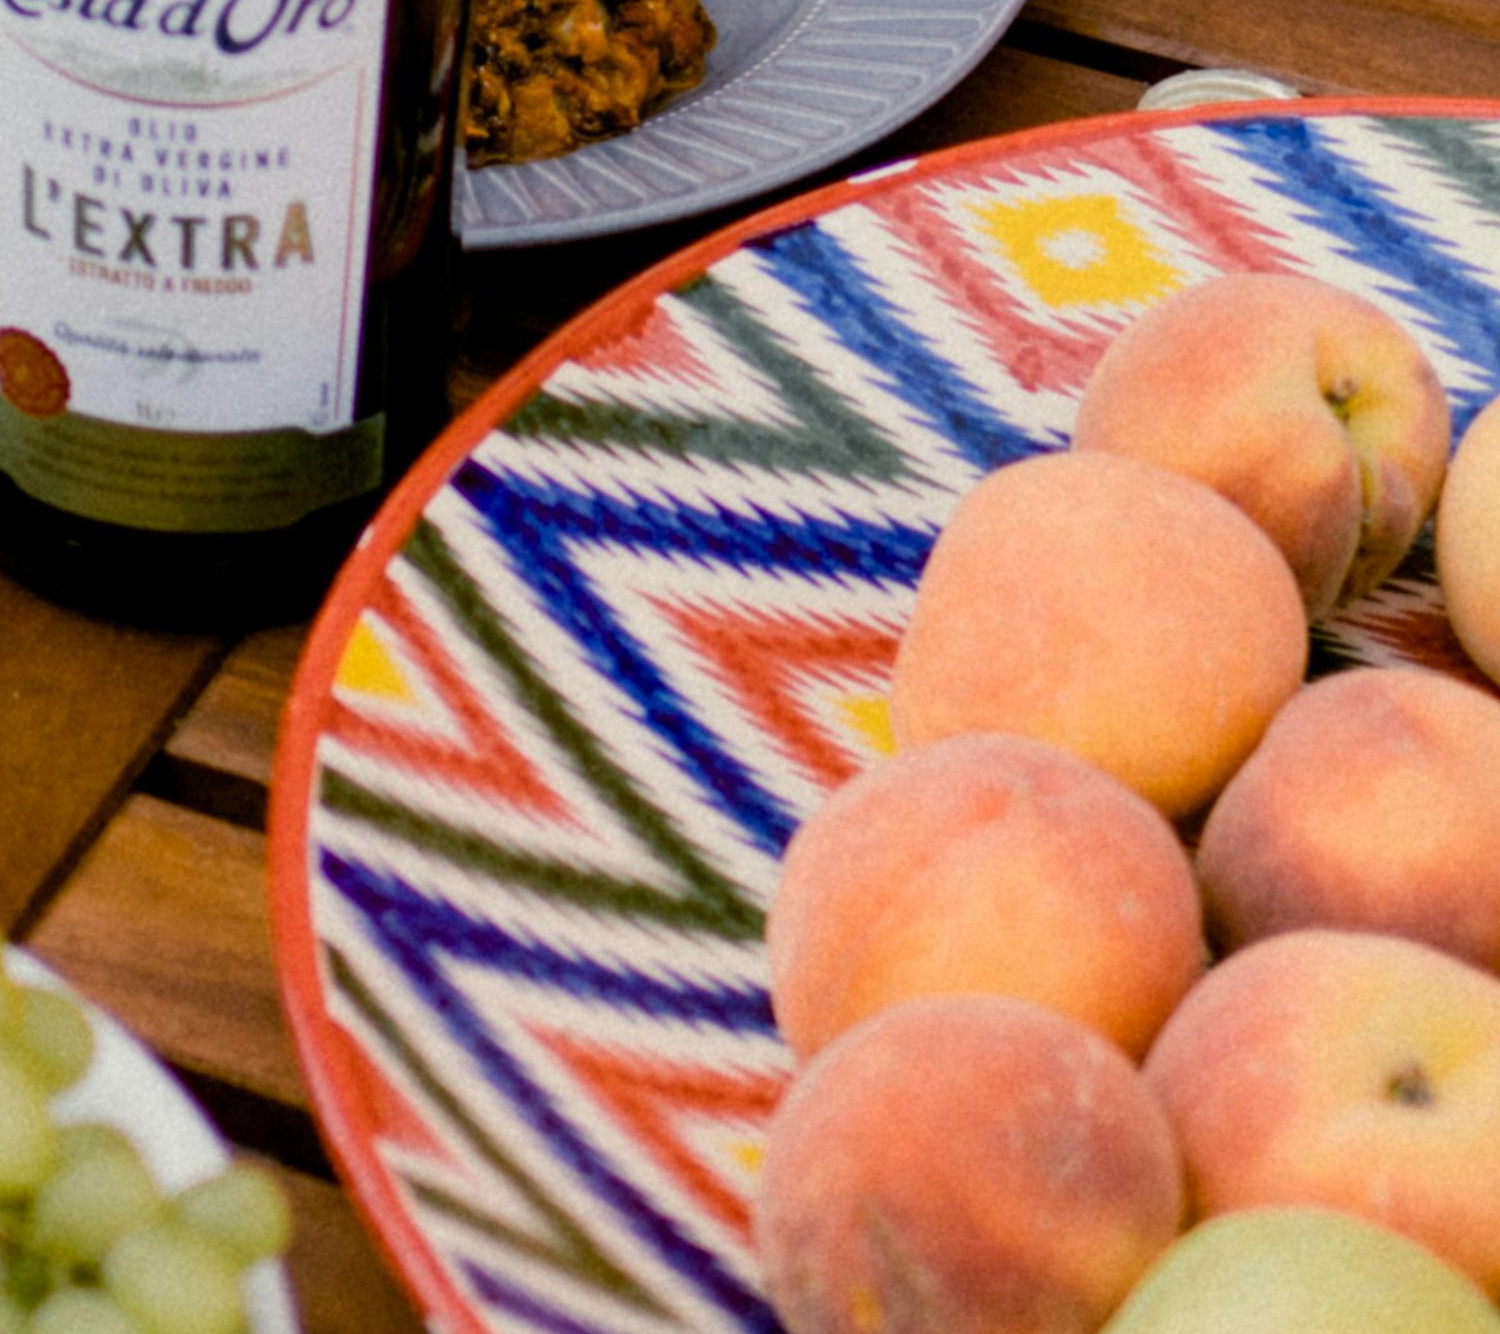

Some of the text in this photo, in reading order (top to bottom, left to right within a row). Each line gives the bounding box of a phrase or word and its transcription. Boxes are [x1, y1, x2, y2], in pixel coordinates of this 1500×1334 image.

[44, 121, 290, 171] EXTRA VERGINE
[128, 117, 198, 143] OLIO
[94, 165, 232, 199] DI OLIVA
[22, 163, 316, 271] L'EXTRA
[69, 256, 253, 296] ESTRATTO A FREDDO
